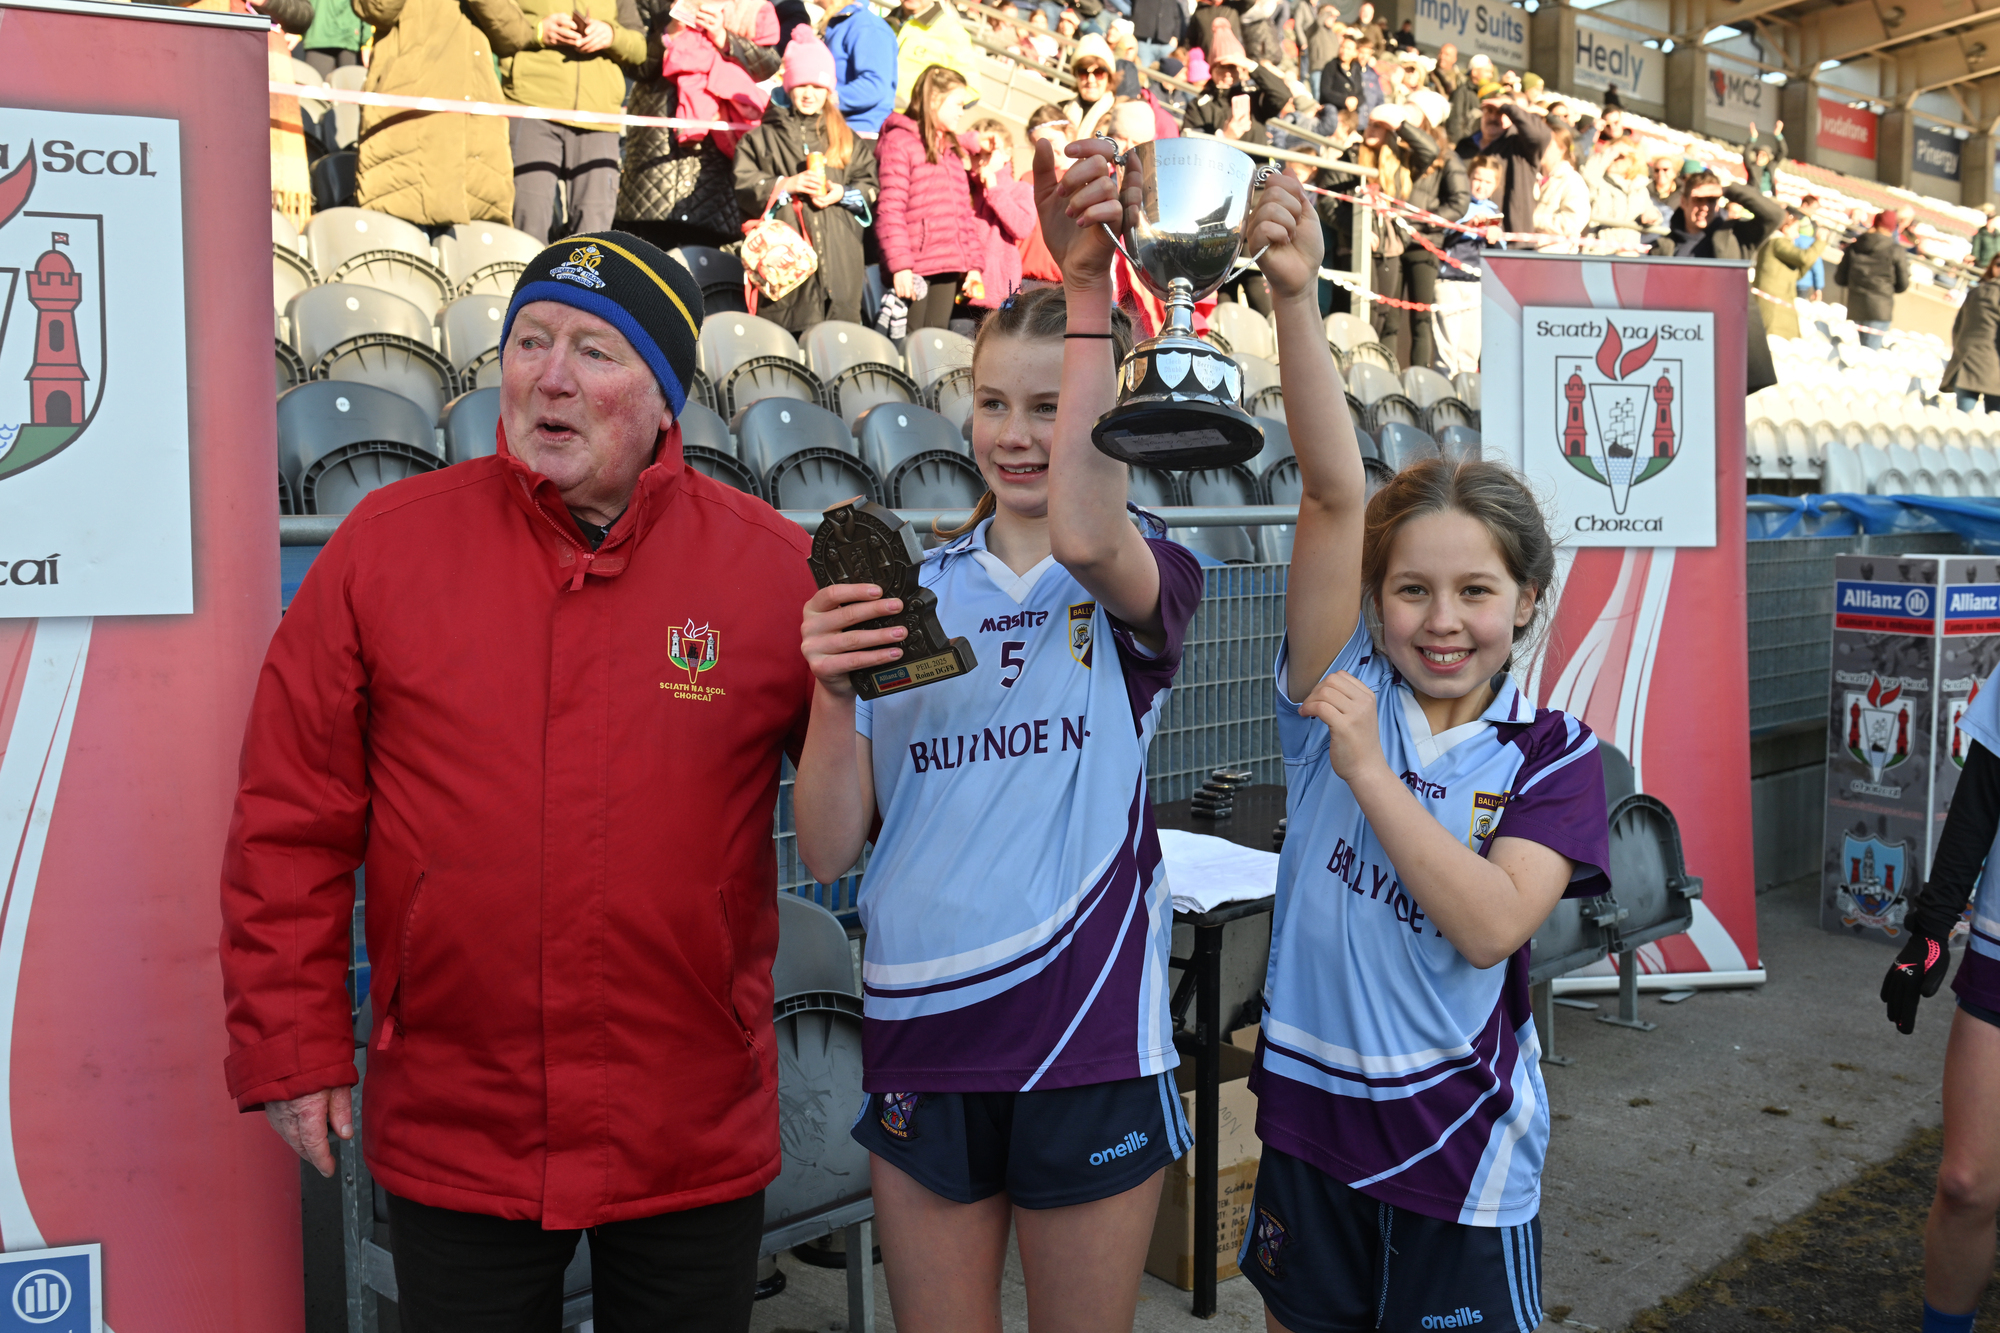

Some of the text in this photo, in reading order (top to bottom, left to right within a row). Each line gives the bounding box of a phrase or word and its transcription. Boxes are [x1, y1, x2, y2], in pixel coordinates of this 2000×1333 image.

[1475, 5, 1524, 44] Suits
[1577, 29, 1644, 93] Healy
[1823, 115, 1869, 143] vodafone
[42, 140, 157, 178] Scol
[1154, 153, 1202, 168] Sciath
[1208, 159, 1224, 171] na
[1916, 139, 1959, 175] Pinergy
[1536, 320, 1704, 342] Sciath na Scol
[1574, 514, 1664, 532] Chorcaí
[1843, 588, 1902, 610] Allianz
[1949, 593, 1997, 612] Allianz
[915, 657, 948, 672] PEIL 2025
[915, 664, 955, 681] Roinn DGF8
[999, 640, 1028, 690] 5
[659, 682, 726, 695] SCIATH NA SCOL
[879, 673, 898, 682] Allianz
